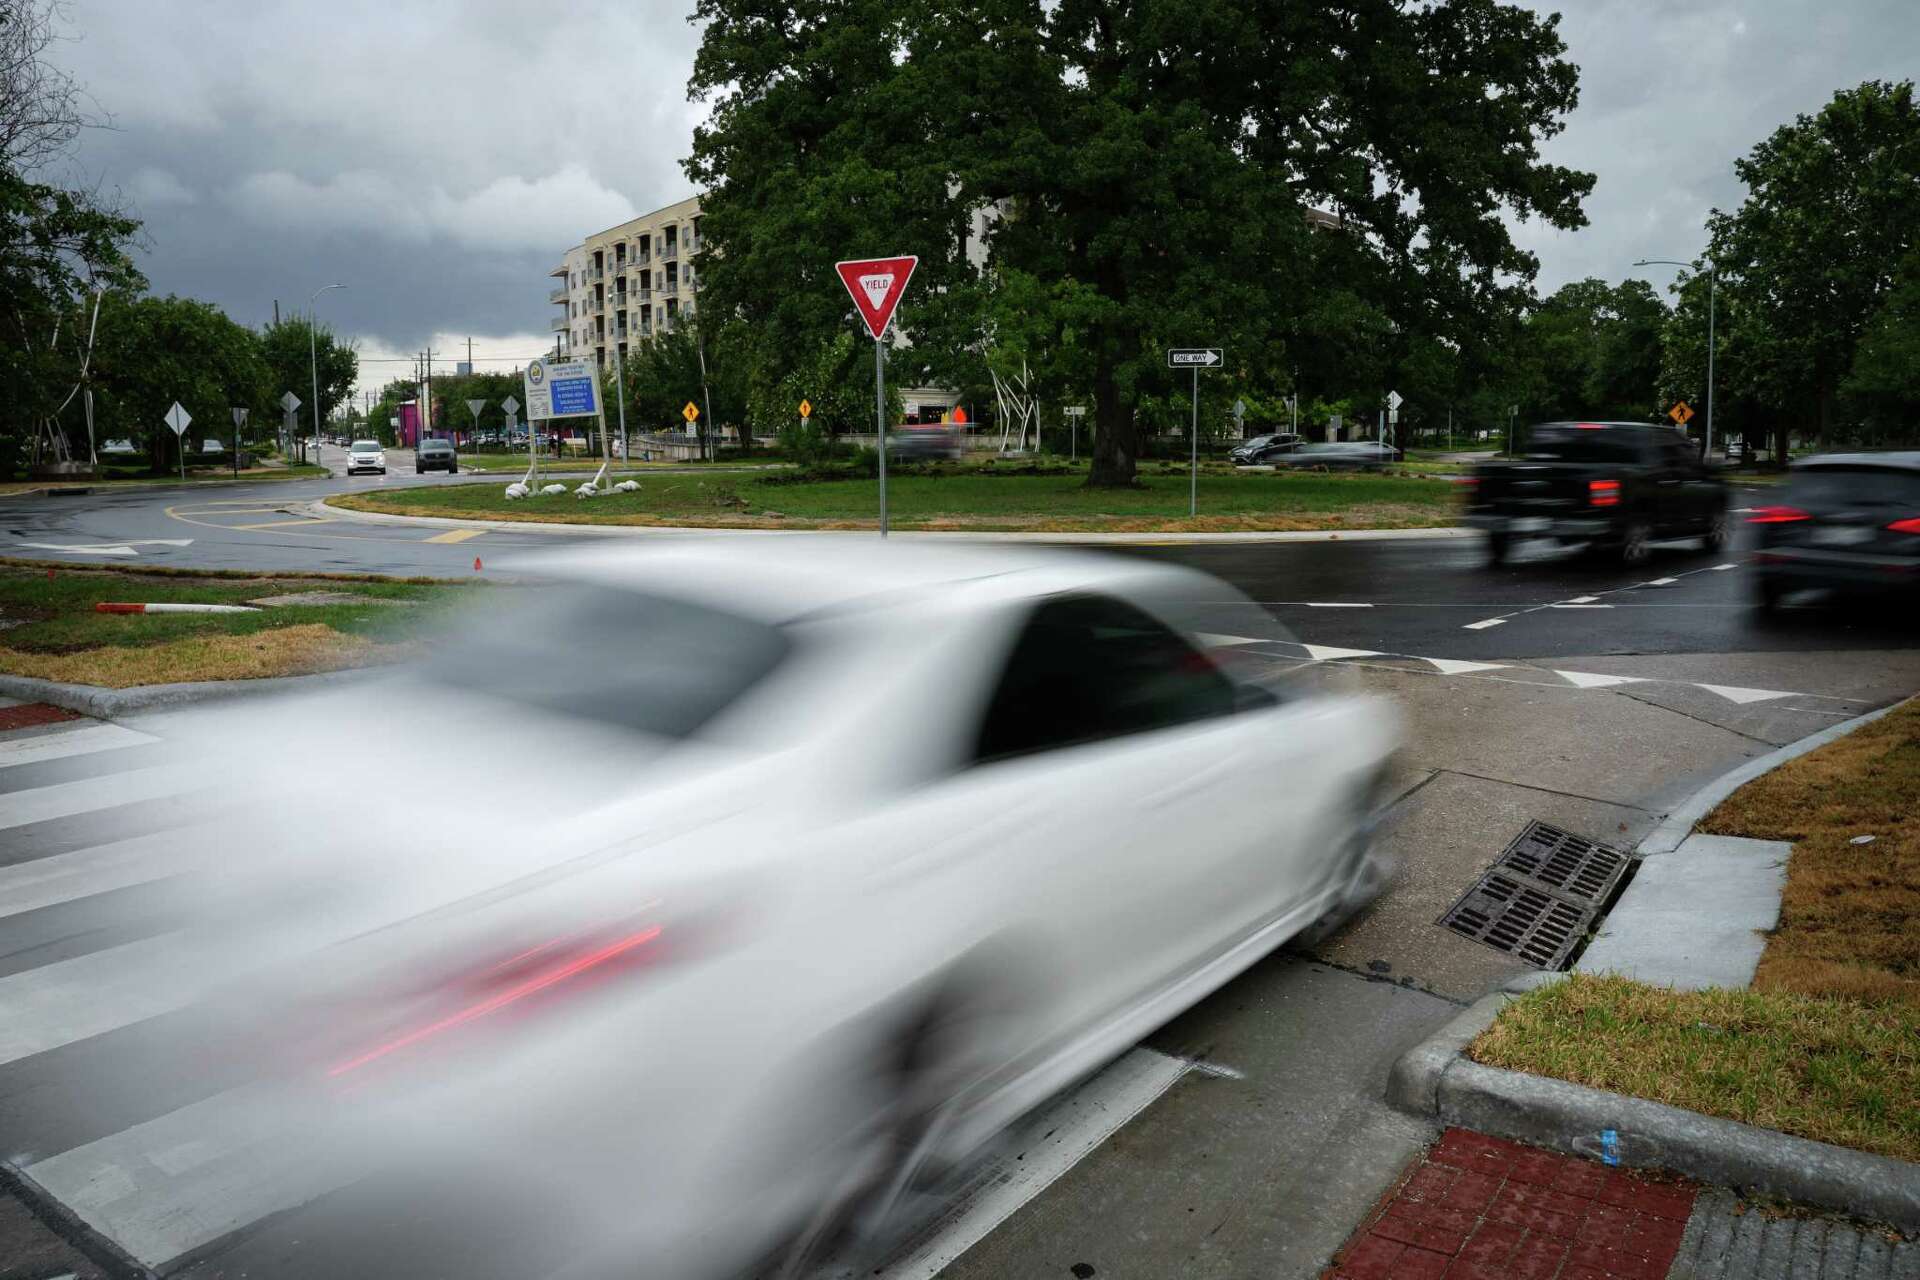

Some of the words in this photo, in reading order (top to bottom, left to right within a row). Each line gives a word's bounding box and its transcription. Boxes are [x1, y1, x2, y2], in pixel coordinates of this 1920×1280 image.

[865, 279, 888, 289] YIELD
[1175, 353, 1190, 362] ONE
[1191, 353, 1207, 362] WAY
